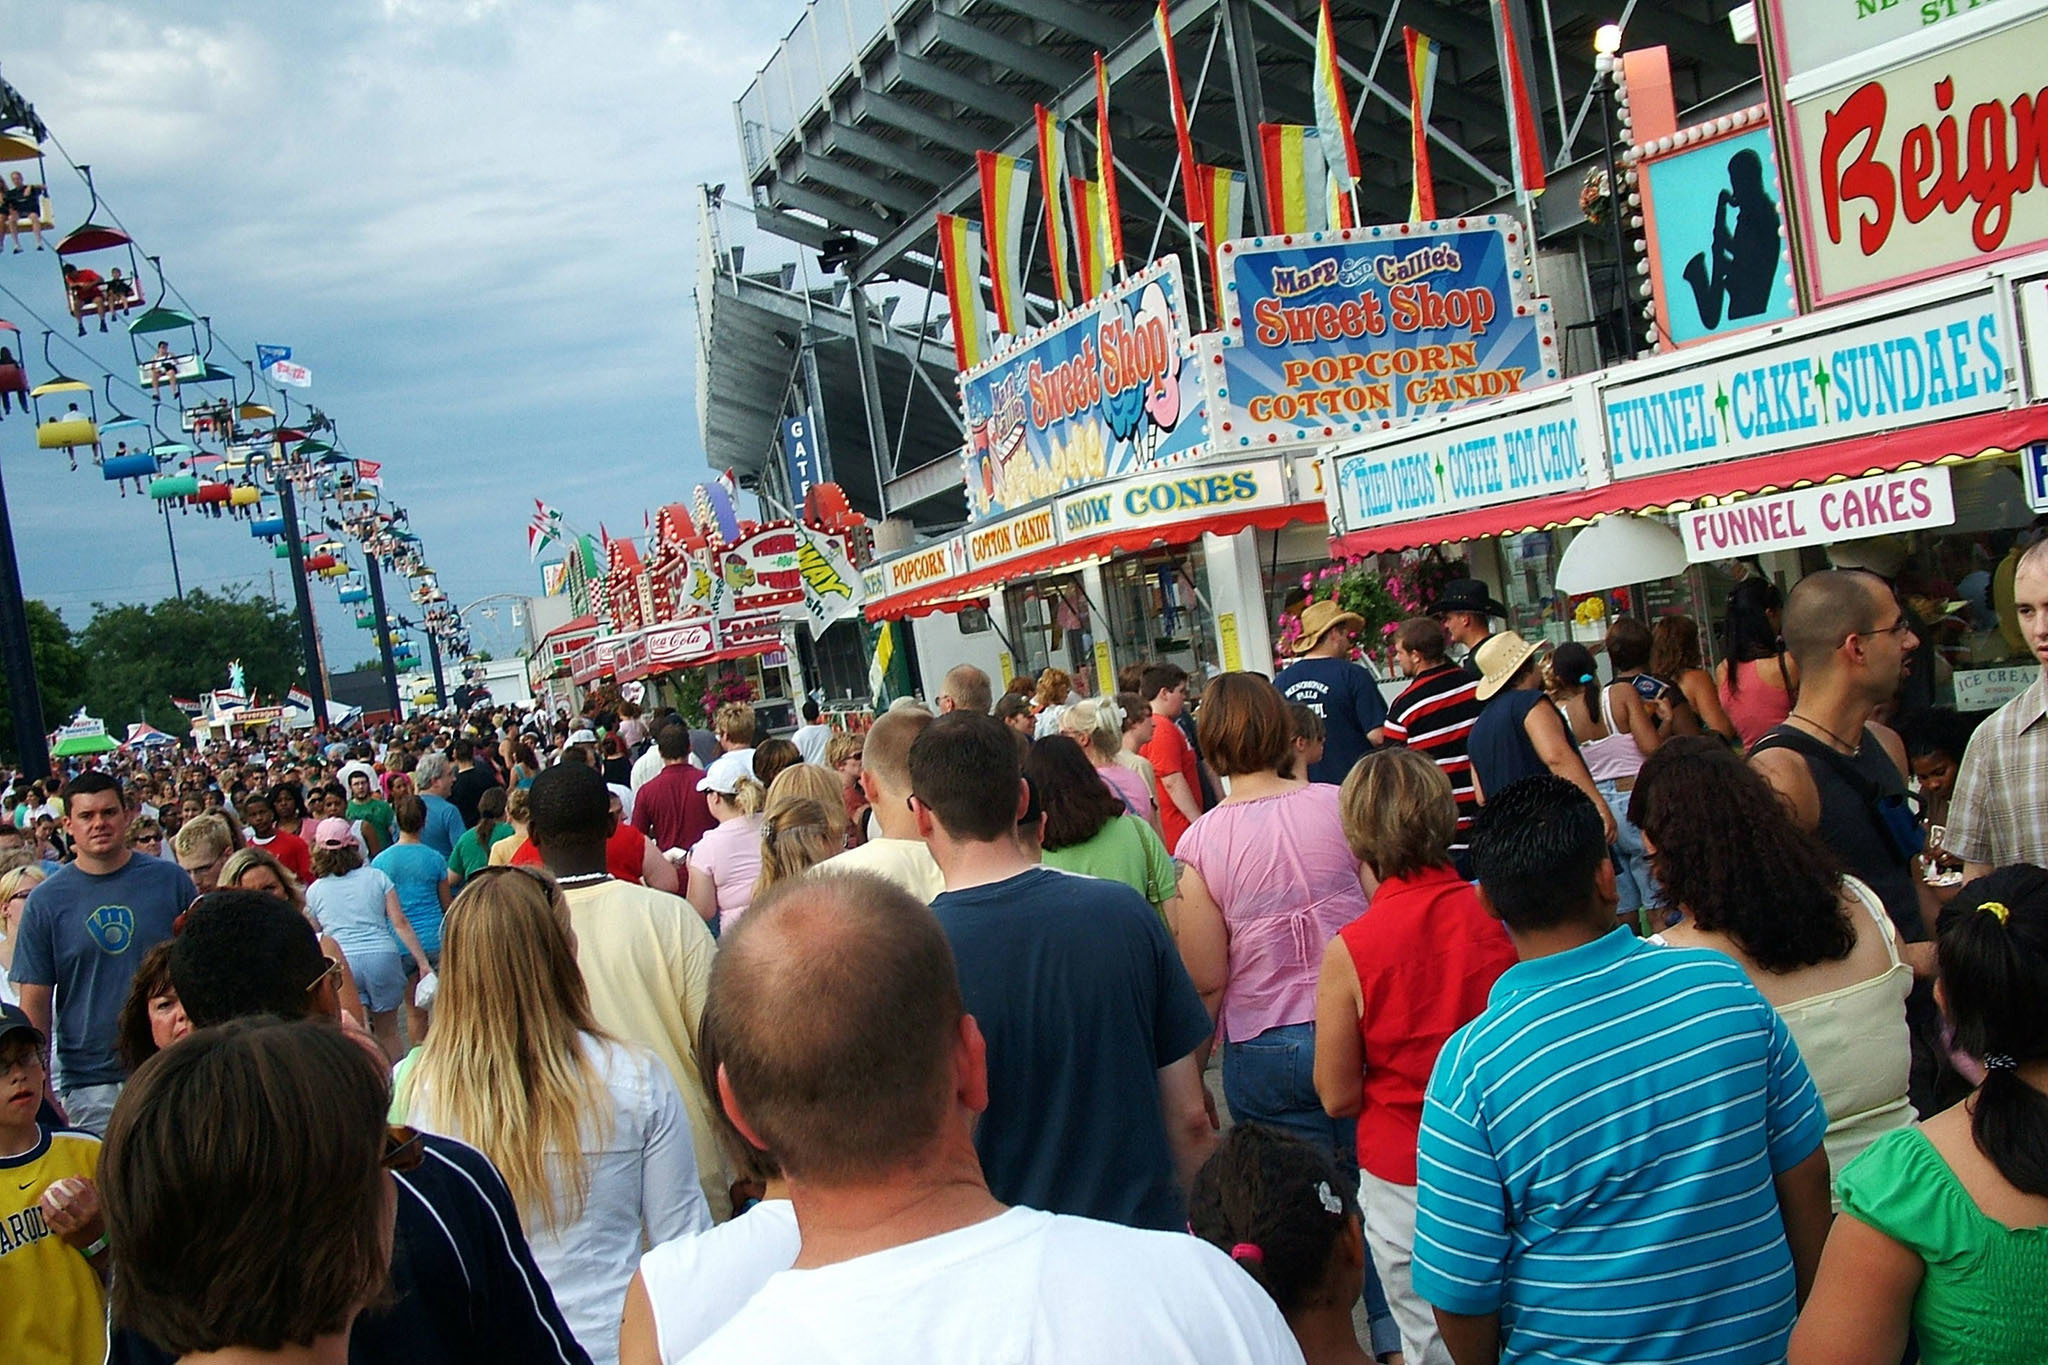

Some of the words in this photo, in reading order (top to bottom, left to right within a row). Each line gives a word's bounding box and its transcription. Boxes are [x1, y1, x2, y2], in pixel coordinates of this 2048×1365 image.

[1273, 258, 1338, 296] Mary
[1376, 245, 1461, 286] Callie's
[1255, 290, 1386, 346] Sweet
[1389, 283, 1495, 334] Shop
[1027, 335, 1102, 430] Sweet
[1099, 316, 1169, 397] Shop
[1284, 342, 1478, 388] POPCORN
[1607, 384, 1717, 465] FUNNEL
[1731, 358, 1819, 440] CAKE
[1831, 313, 2004, 422] SUNDAES
[1250, 384, 1391, 422] COTTON
[1406, 369, 1524, 404] CANDY
[1355, 462, 1392, 518] FRIED
[1391, 452, 1435, 510] OREOS
[1448, 436, 1503, 499] COFFEE
[1504, 428, 1538, 489] HOT
[1066, 492, 1112, 532] SNOW
[1124, 470, 1258, 517] CONES
[1692, 500, 1807, 551] FUNNEL
[1819, 478, 1933, 528] CAKES
[971, 525, 1013, 562] COTTON
[1013, 512, 1053, 552] CANDY
[892, 550, 946, 587] POPCORN
[1958, 673, 1982, 692] ICE
[0, 1205, 57, 1255] ARQU
